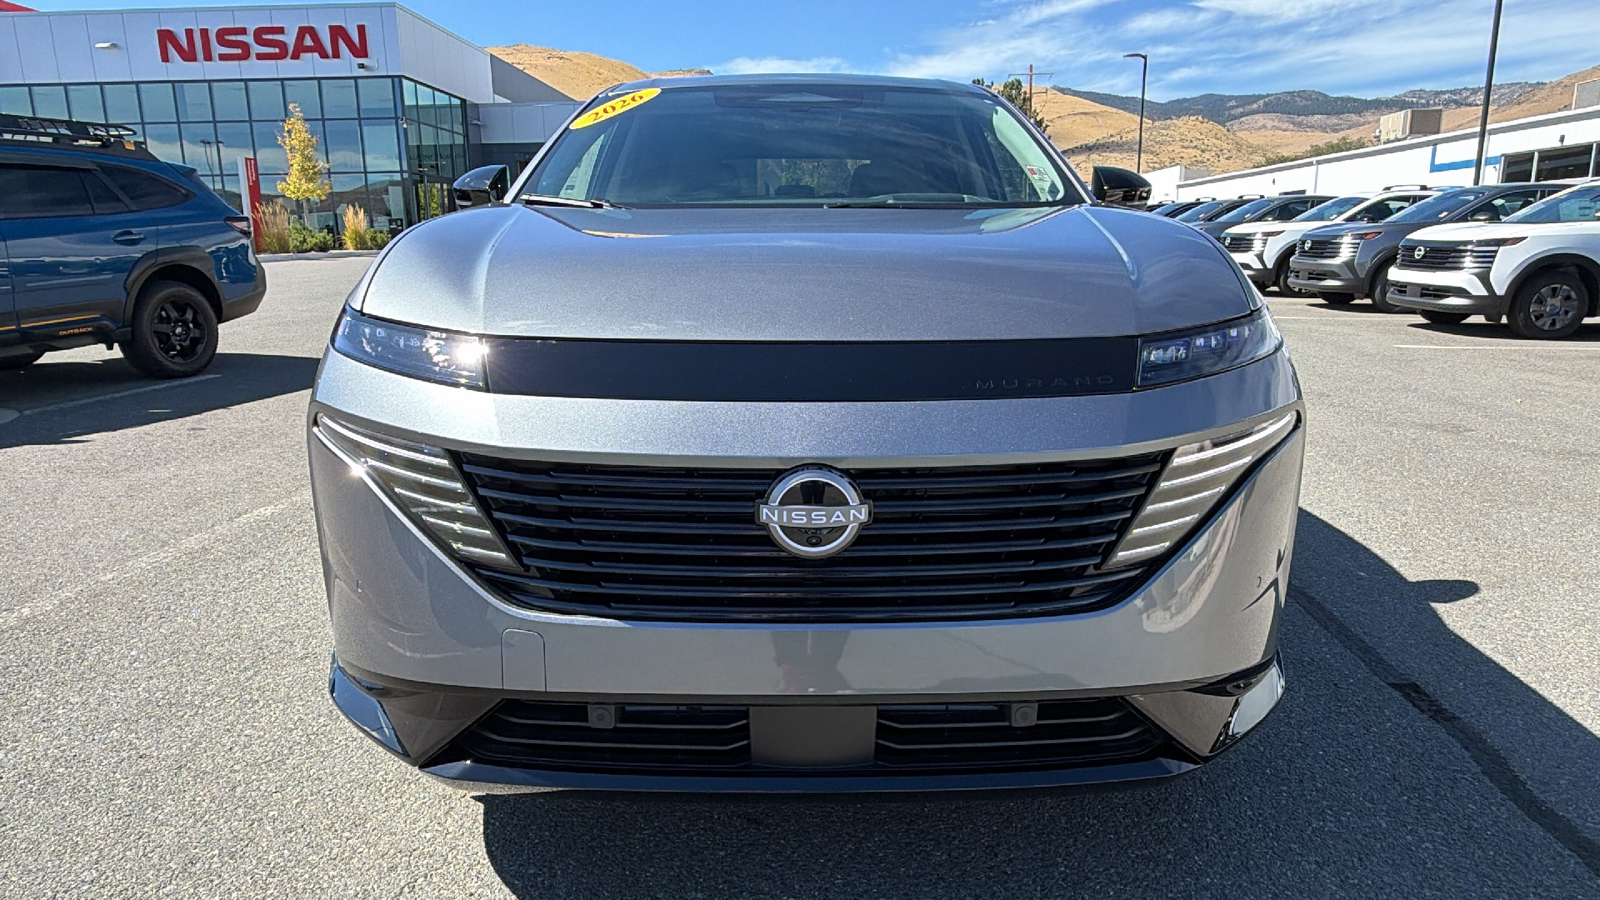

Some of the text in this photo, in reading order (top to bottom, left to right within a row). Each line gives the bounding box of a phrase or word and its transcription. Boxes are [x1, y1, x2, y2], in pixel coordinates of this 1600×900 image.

[156, 24, 369, 63] NISSAN
[588, 94, 644, 122] 2026
[59, 326, 93, 336] OUTBACK
[975, 374, 1114, 389] MURANO
[762, 507, 866, 524] NISSAN
